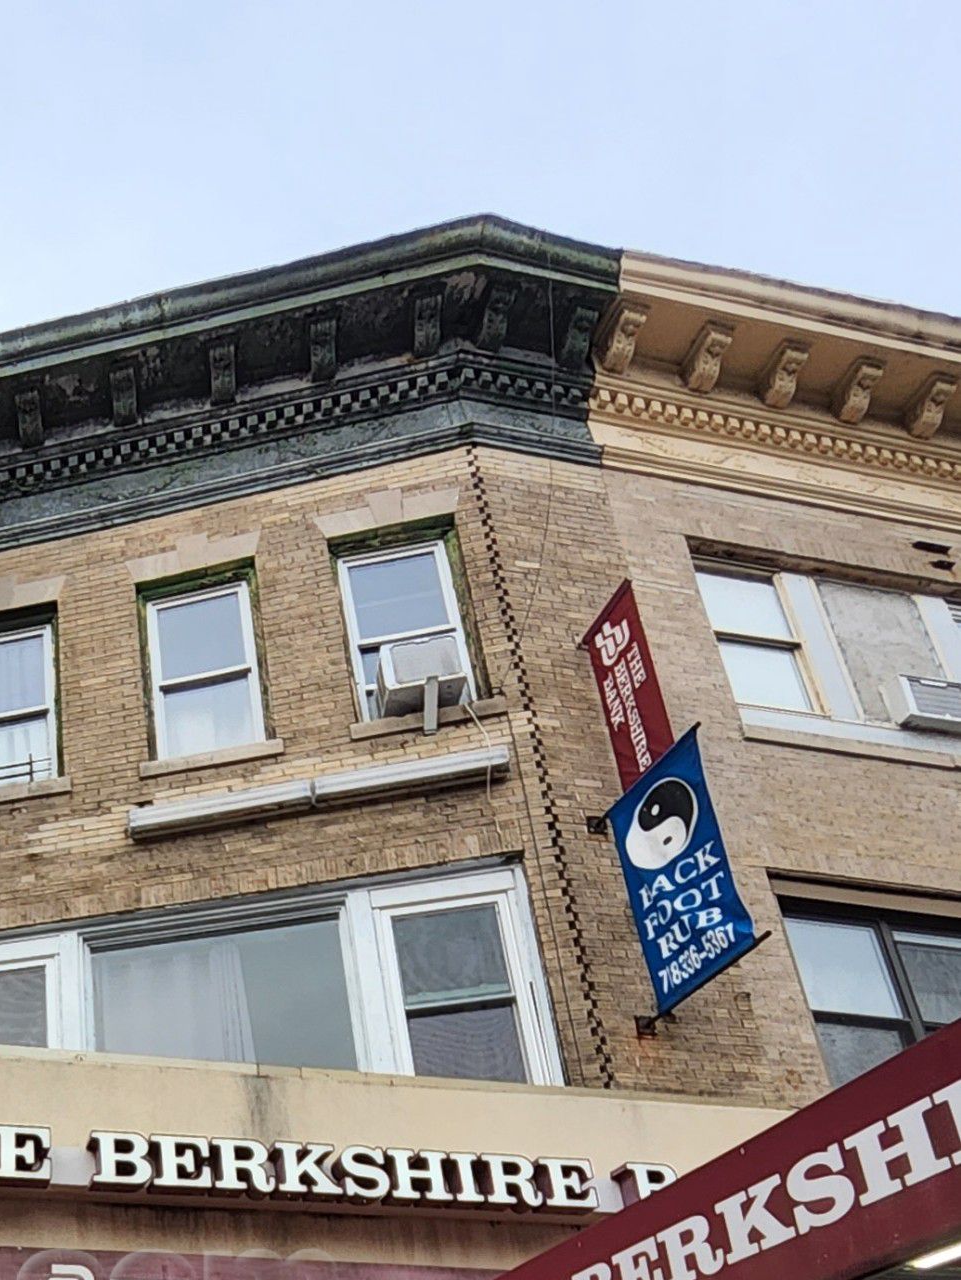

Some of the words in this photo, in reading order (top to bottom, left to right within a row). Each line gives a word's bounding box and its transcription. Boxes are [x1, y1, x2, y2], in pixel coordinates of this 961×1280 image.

[626, 641, 647, 689] THE
[603, 671, 625, 731] BANK
[614, 657, 653, 772] BERKSHIRE
[656, 906, 724, 960] RUB
[88, 1128, 601, 1212] BERKSHIRE
